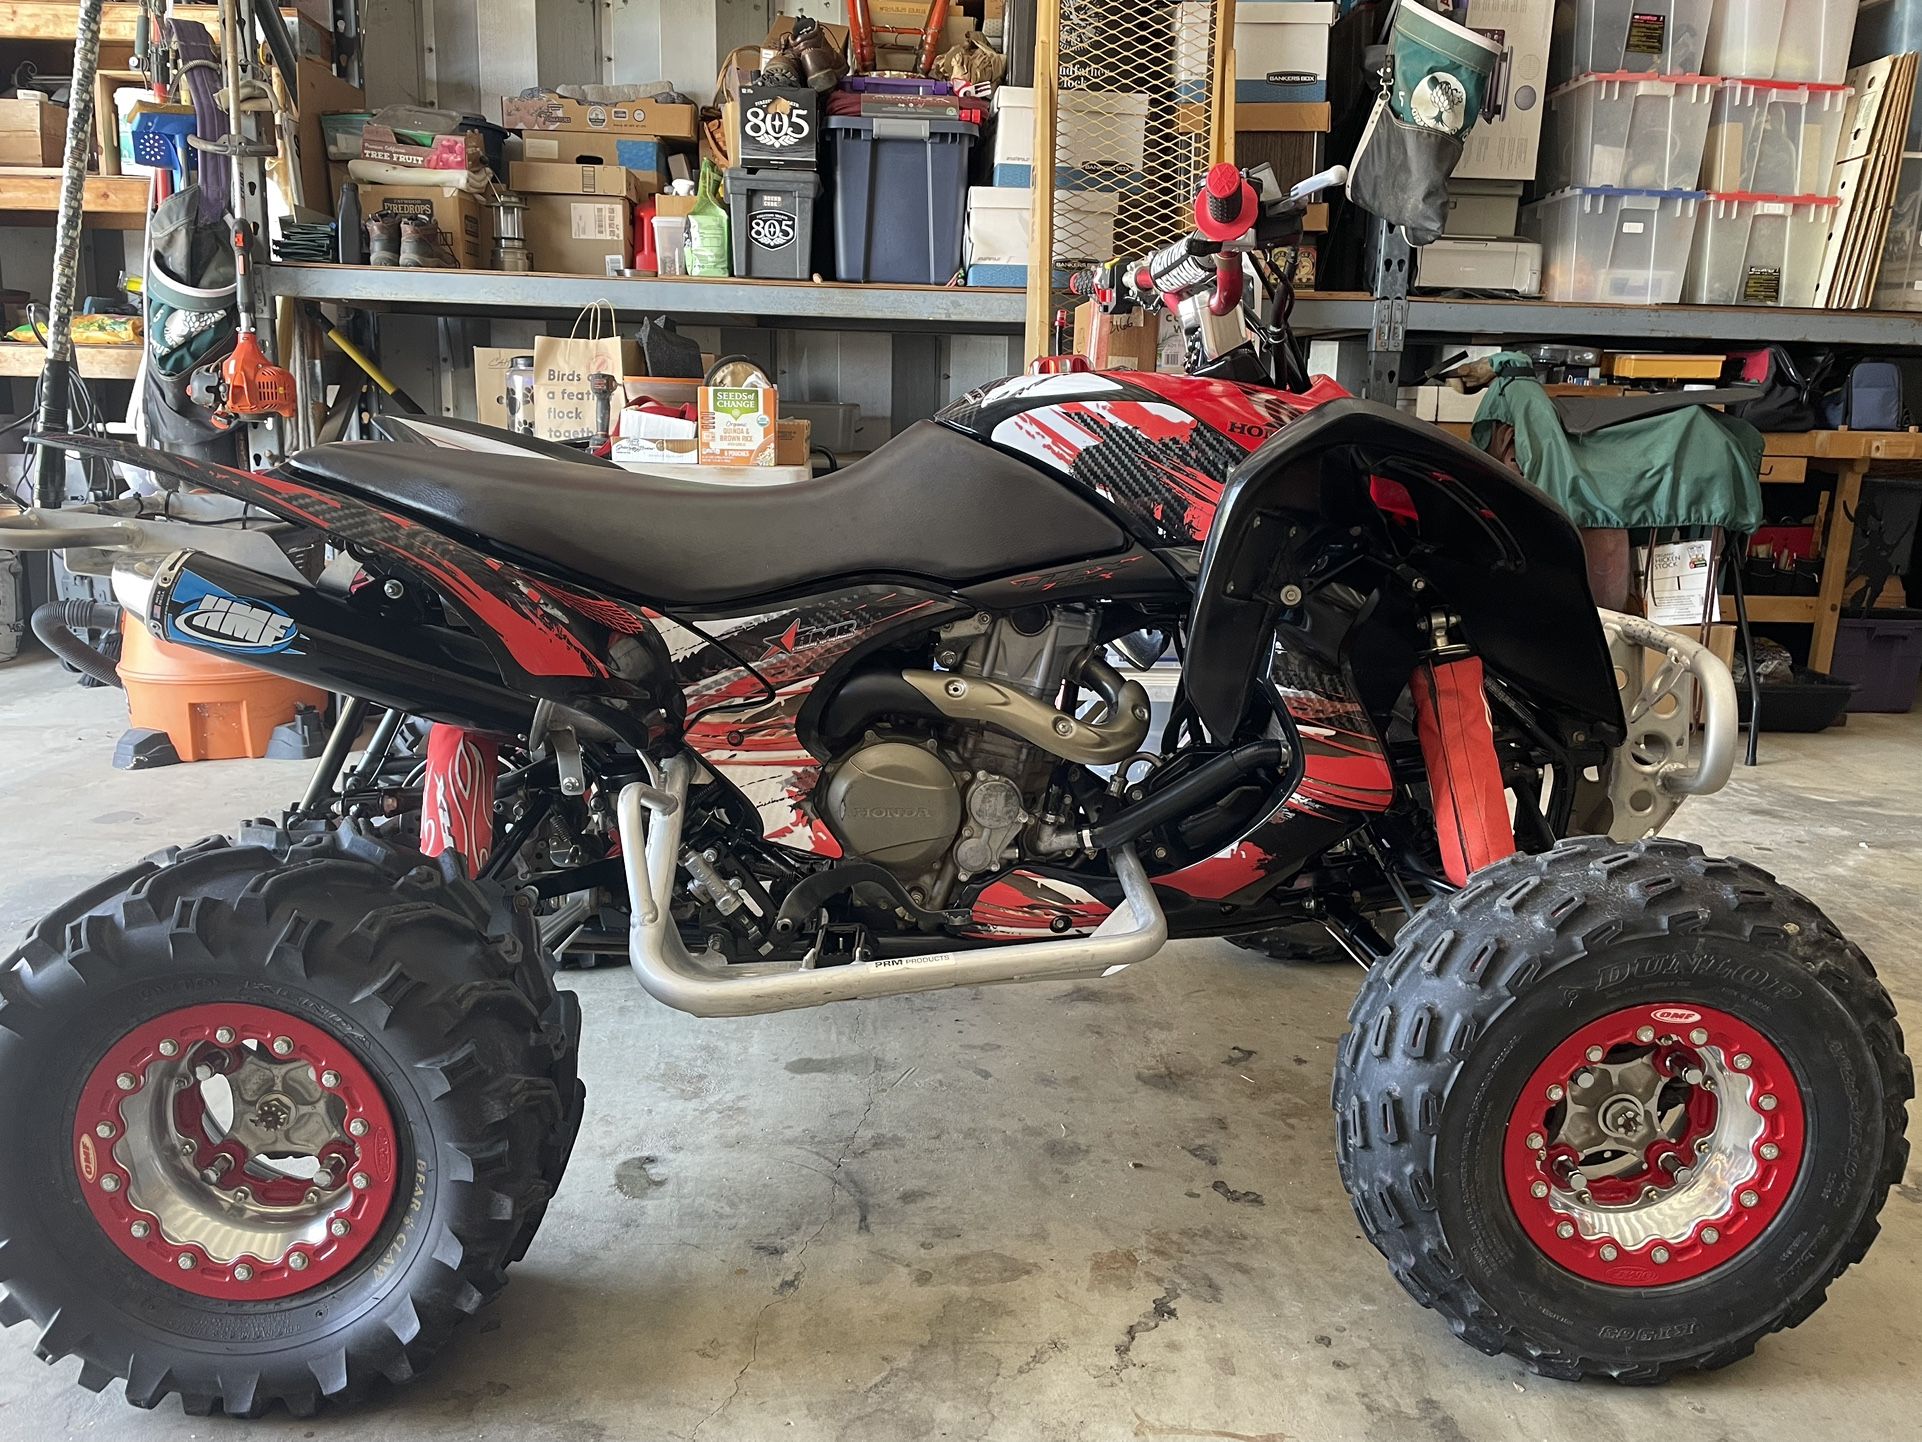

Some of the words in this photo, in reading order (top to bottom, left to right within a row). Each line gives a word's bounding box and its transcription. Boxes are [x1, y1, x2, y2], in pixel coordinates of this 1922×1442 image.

[745, 107, 809, 138] 805
[364, 150, 391, 160] TREE
[393, 154, 424, 165] FRUIT
[384, 203, 432, 214] FIREDROPS
[751, 219, 794, 240] 805
[548, 369, 581, 382] Birds
[716, 391, 748, 400] SEEDS
[748, 392, 756, 401] of
[716, 400, 756, 408] CHANGE
[548, 408, 583, 420] flock
[1655, 562, 1678, 570] STOCK
[192, 593, 295, 647] HMF
[854, 807, 932, 818] HONDA
[875, 959, 903, 968] PRM
[905, 954, 950, 965] PRODUCTS
[1595, 953, 1802, 999] DUNLOP
[1658, 1011, 1696, 1021] OMF
[82, 1141, 92, 1176] OMF
[410, 1158, 428, 1212] BEAR
[373, 1232, 407, 1281] CLAW
